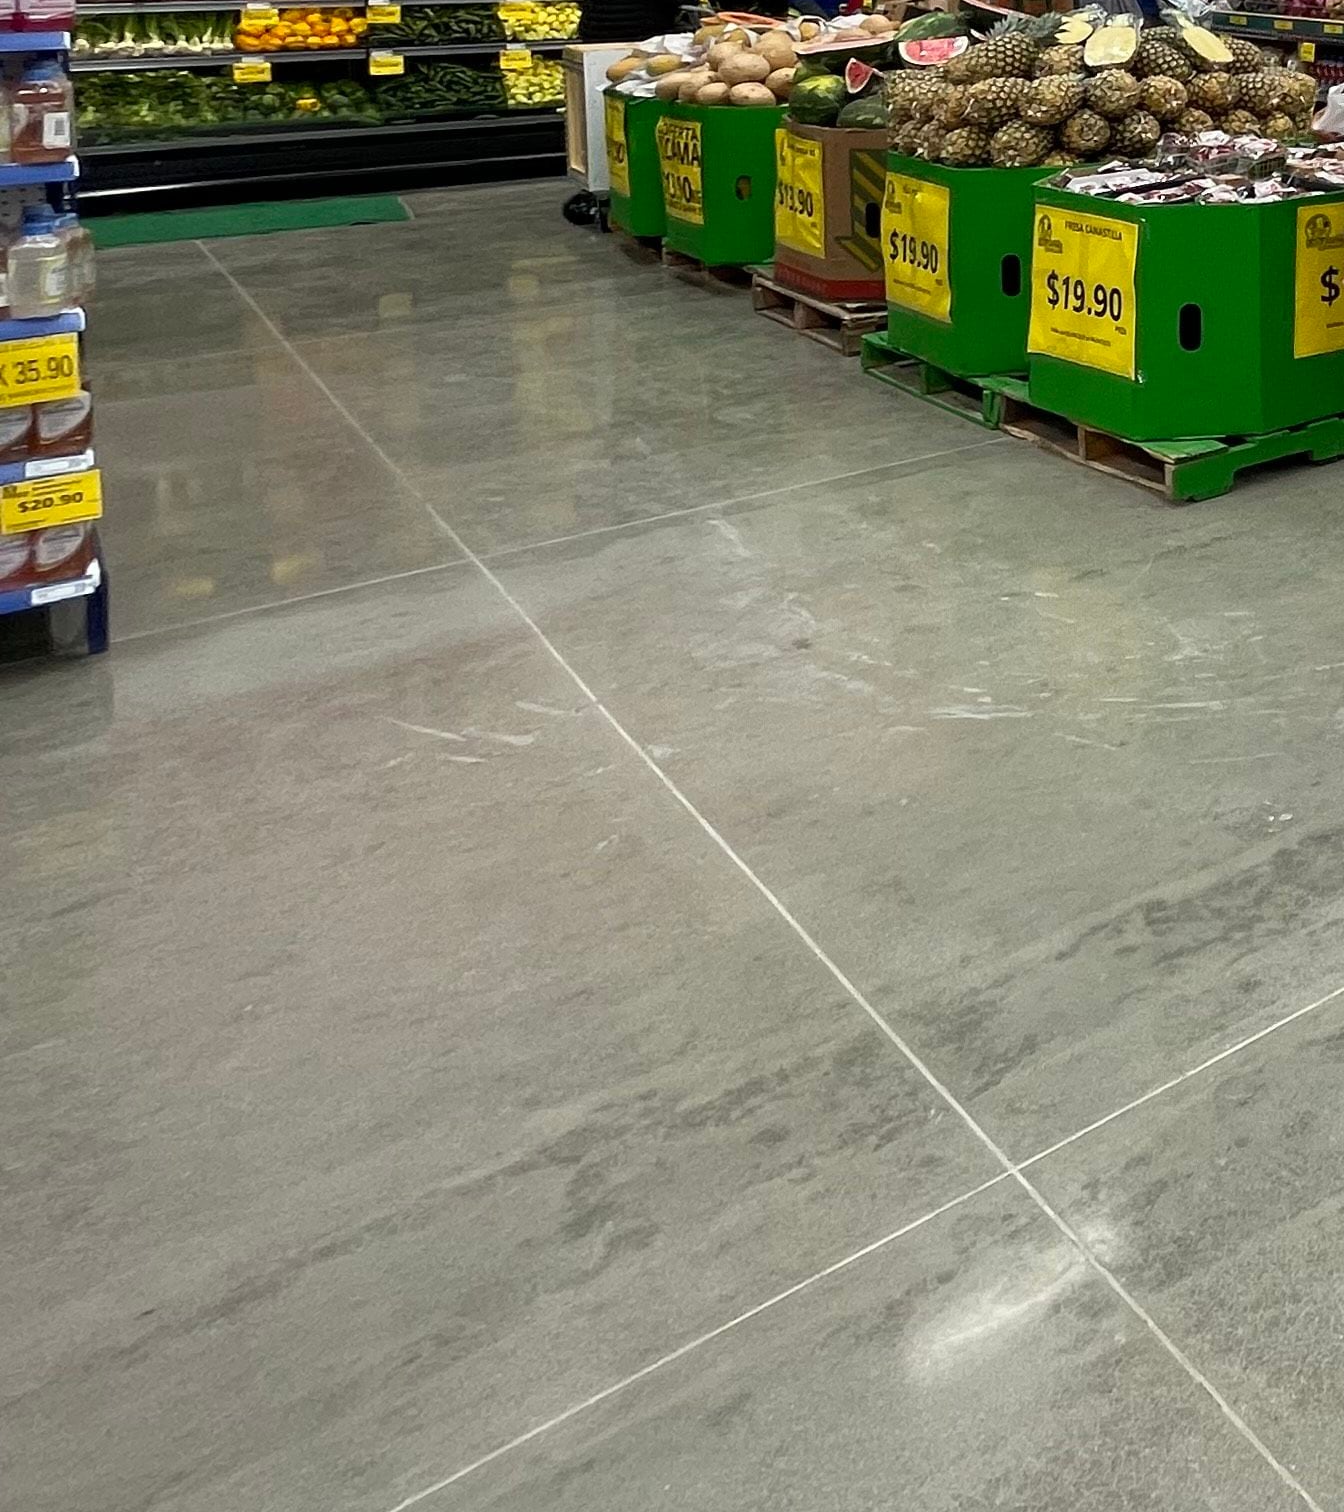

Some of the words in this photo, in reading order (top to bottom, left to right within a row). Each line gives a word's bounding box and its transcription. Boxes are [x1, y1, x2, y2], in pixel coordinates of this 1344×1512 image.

[889, 228, 939, 274] $19.90
[1047, 269, 1123, 322] $19.90
[17, 491, 84, 514] $20.90
